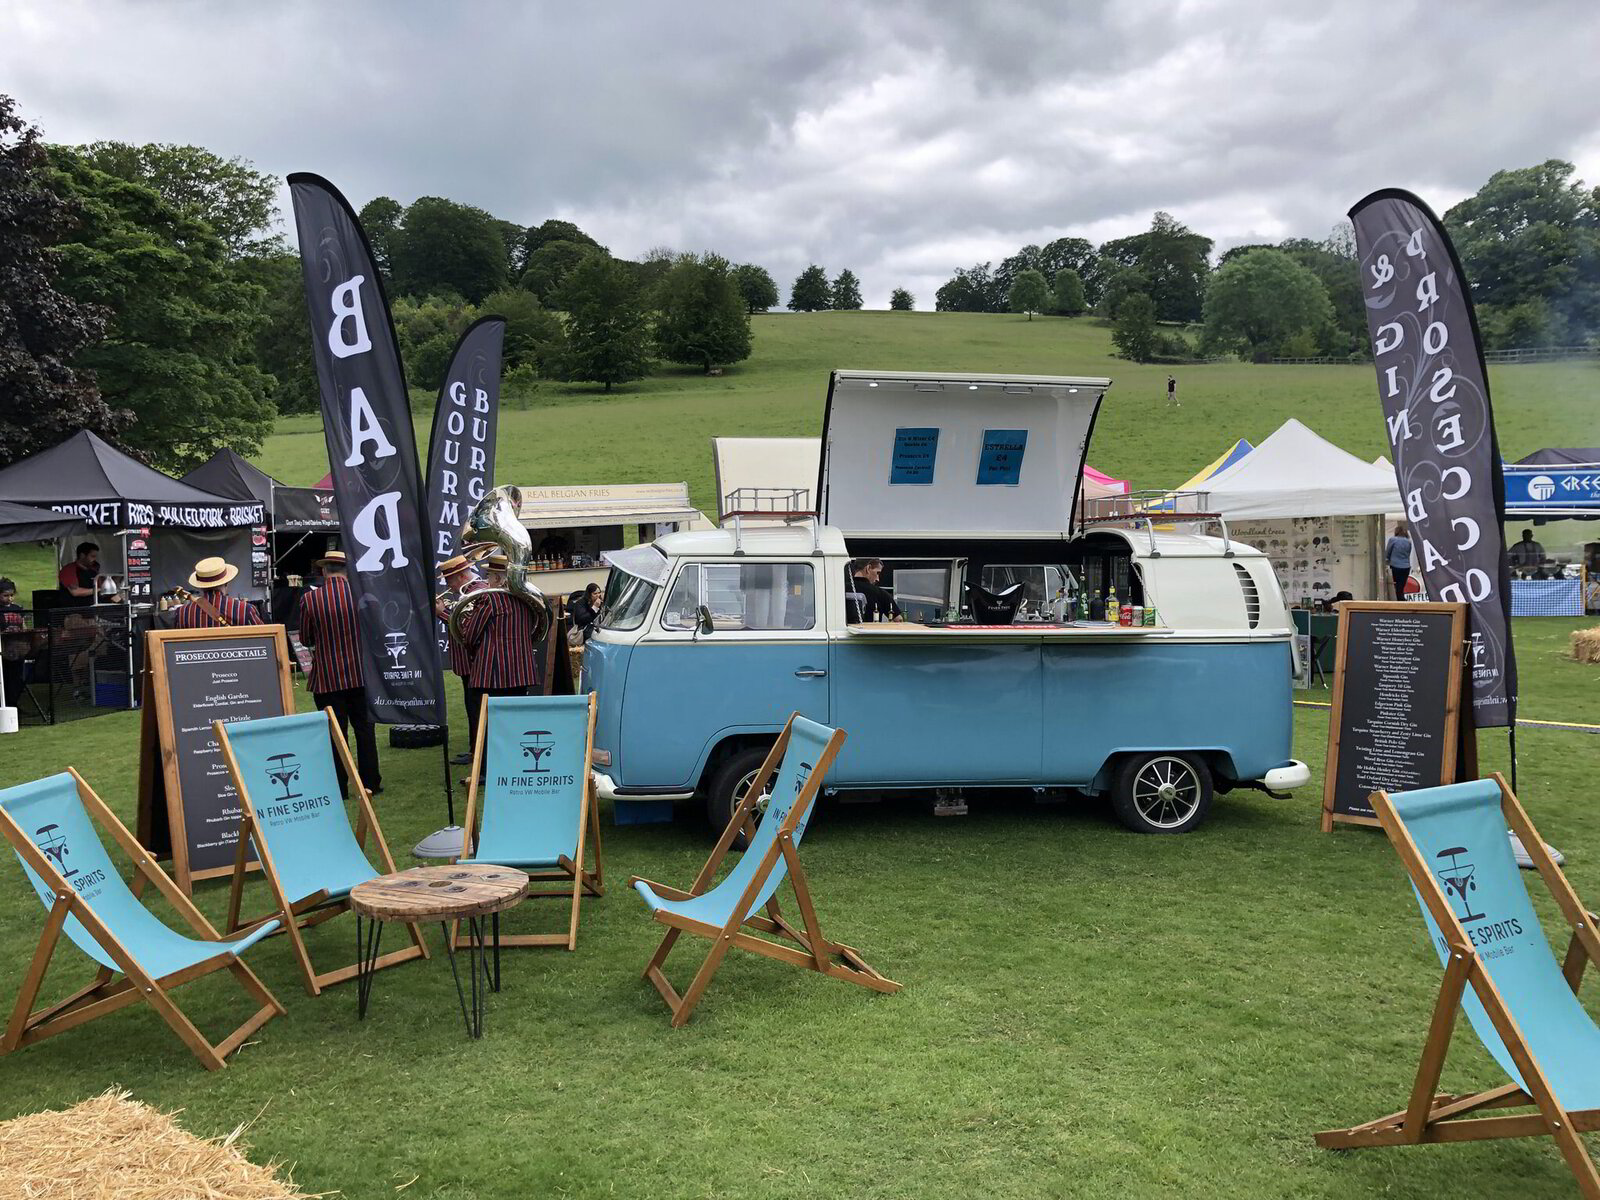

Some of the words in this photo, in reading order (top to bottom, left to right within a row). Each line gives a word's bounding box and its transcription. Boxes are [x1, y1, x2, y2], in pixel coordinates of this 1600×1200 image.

[527, 490, 549, 499] REAL
[551, 489, 587, 498] BELGIAN
[589, 488, 610, 497] FRIES
[51, 503, 121, 526] ISKET
[128, 502, 154, 525] RIBS
[200, 508, 227, 527] PORK
[229, 504, 264, 527] BRISKET
[1231, 527, 1267, 537] Woodland
[175, 651, 219, 662] PROSECCO
[220, 649, 268, 660] COCKTAILS
[211, 671, 238, 679] Prosecco
[205, 695, 227, 703] English
[227, 692, 249, 700] Garden
[497, 776, 508, 786] IN
[511, 776, 534, 787] FINE
[536, 775, 574, 787] SPIRITS
[256, 808, 265, 820] N
[267, 804, 290, 818] FINE
[292, 795, 331, 813] SPIRITS
[293, 814, 310, 822] Mobile
[311, 811, 320, 819] Bar
[44, 890, 56, 904] IN
[73, 869, 106, 892] SPIRITS
[1477, 918, 1523, 945] SPIRITS
[1485, 949, 1504, 960] Mobile
[1503, 945, 1514, 955] Bar
